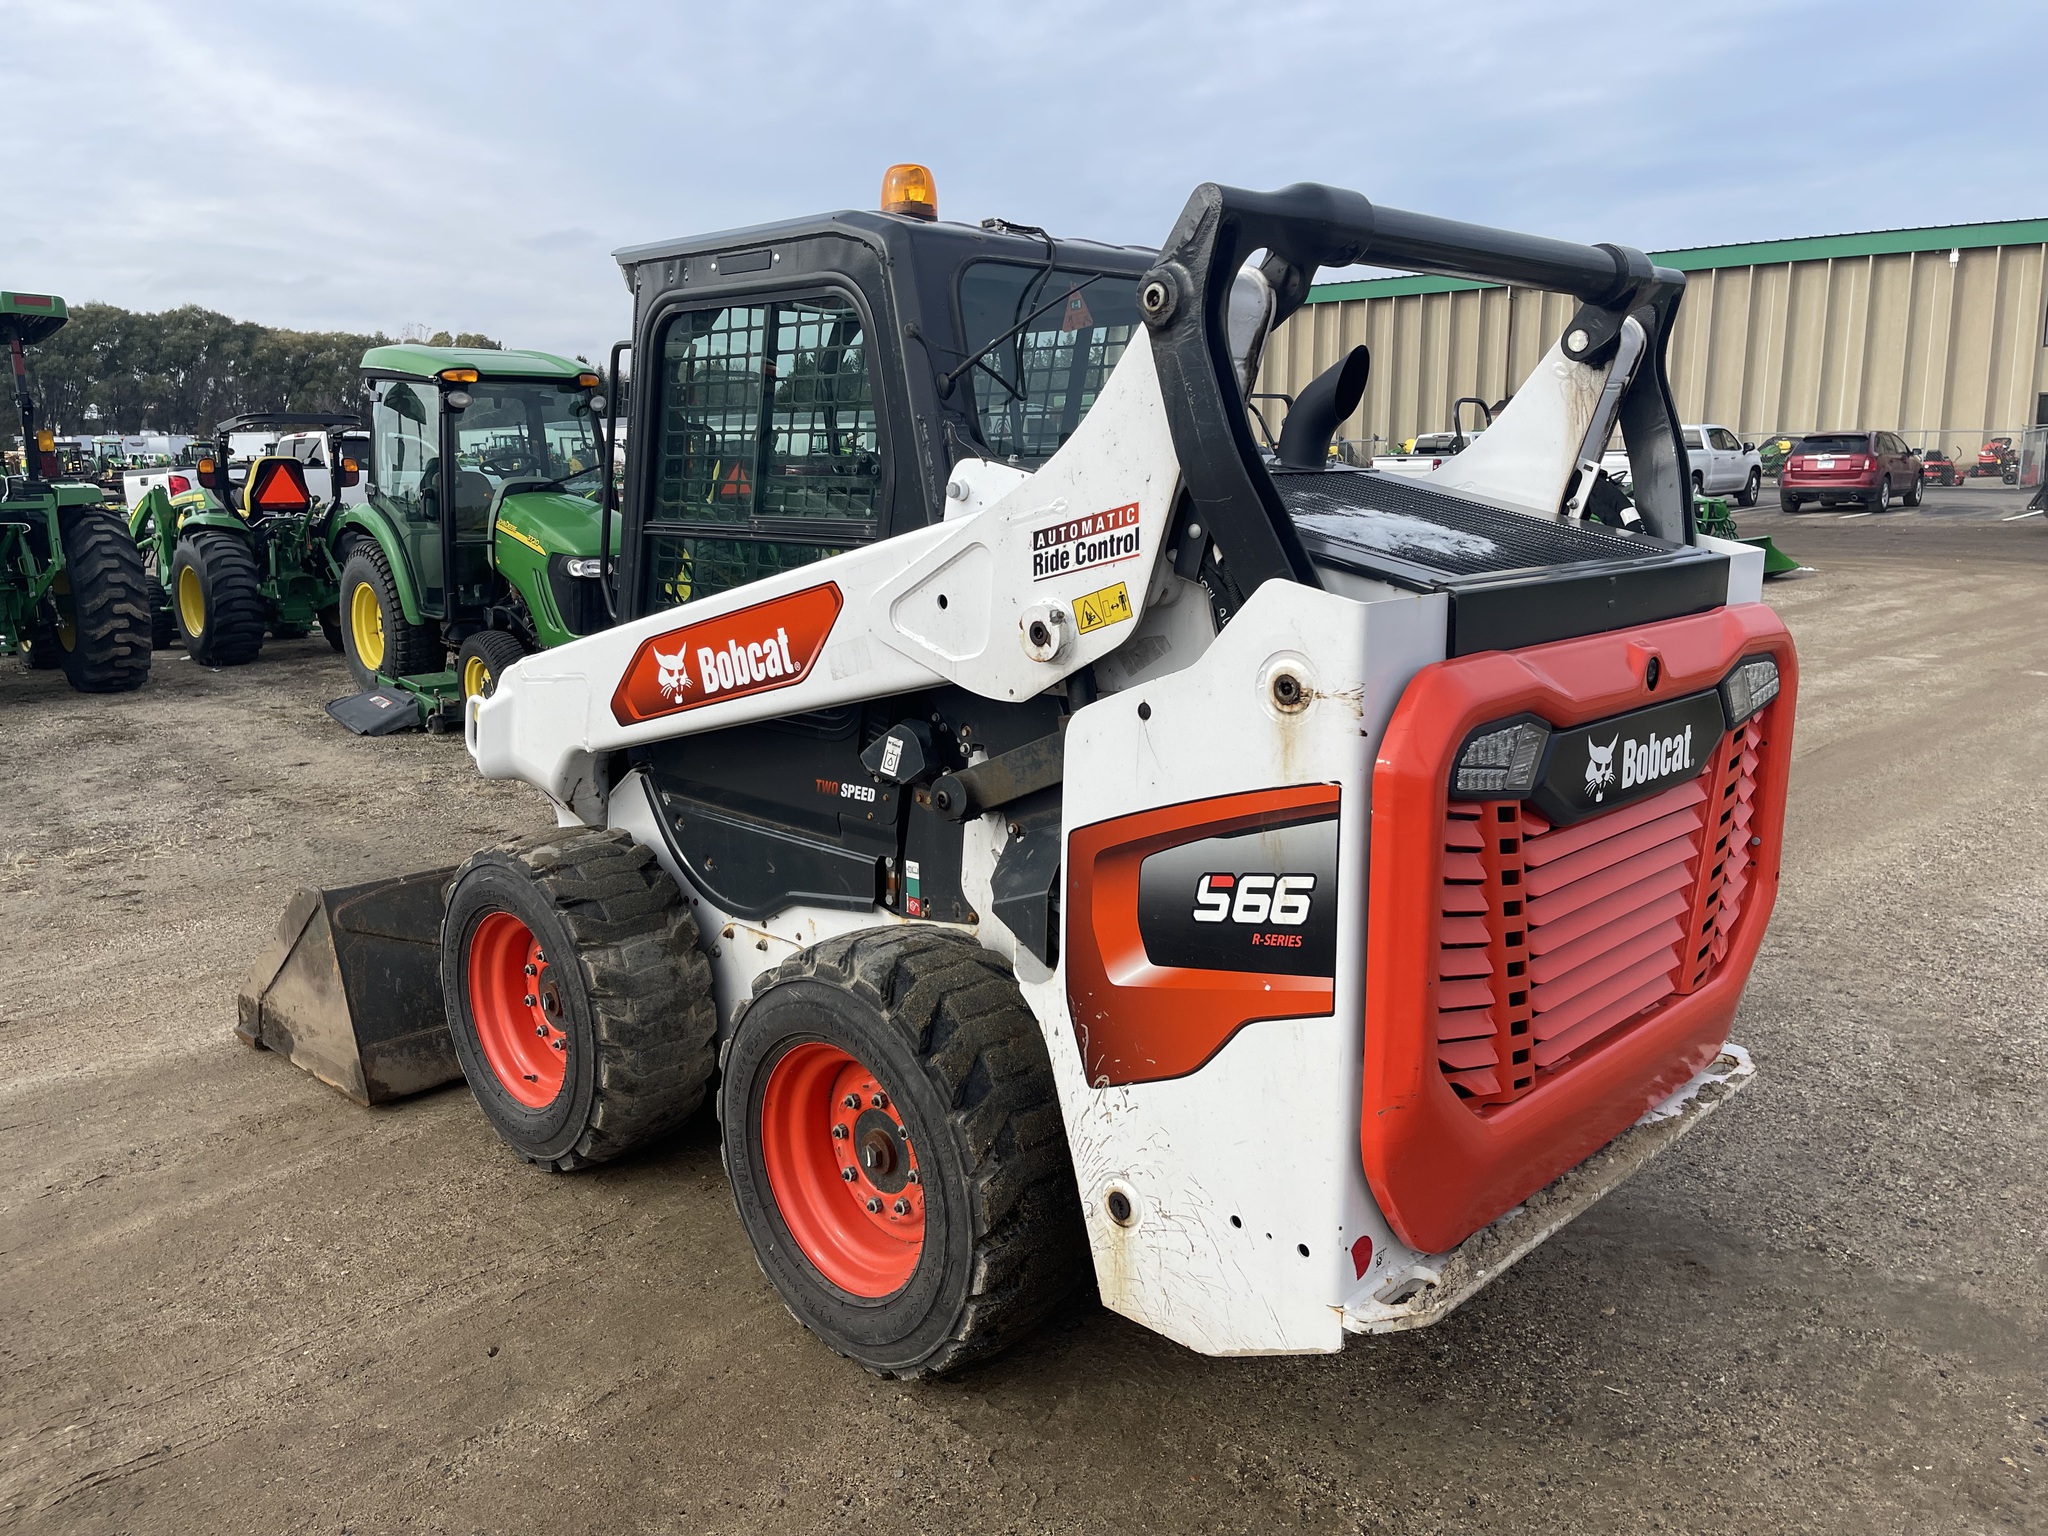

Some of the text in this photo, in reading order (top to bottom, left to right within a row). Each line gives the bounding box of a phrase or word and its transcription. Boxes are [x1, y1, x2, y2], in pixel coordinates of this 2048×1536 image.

[1033, 527, 1140, 577] Ride Control
[1036, 507, 1135, 549] AUTOMATIC
[696, 627, 795, 695] Bobcat
[1621, 724, 1693, 790] Bobcat
[815, 778, 876, 803] TWO SPEED
[1193, 875, 1315, 925] S66
[1251, 932, 1303, 948] R-SERIES
